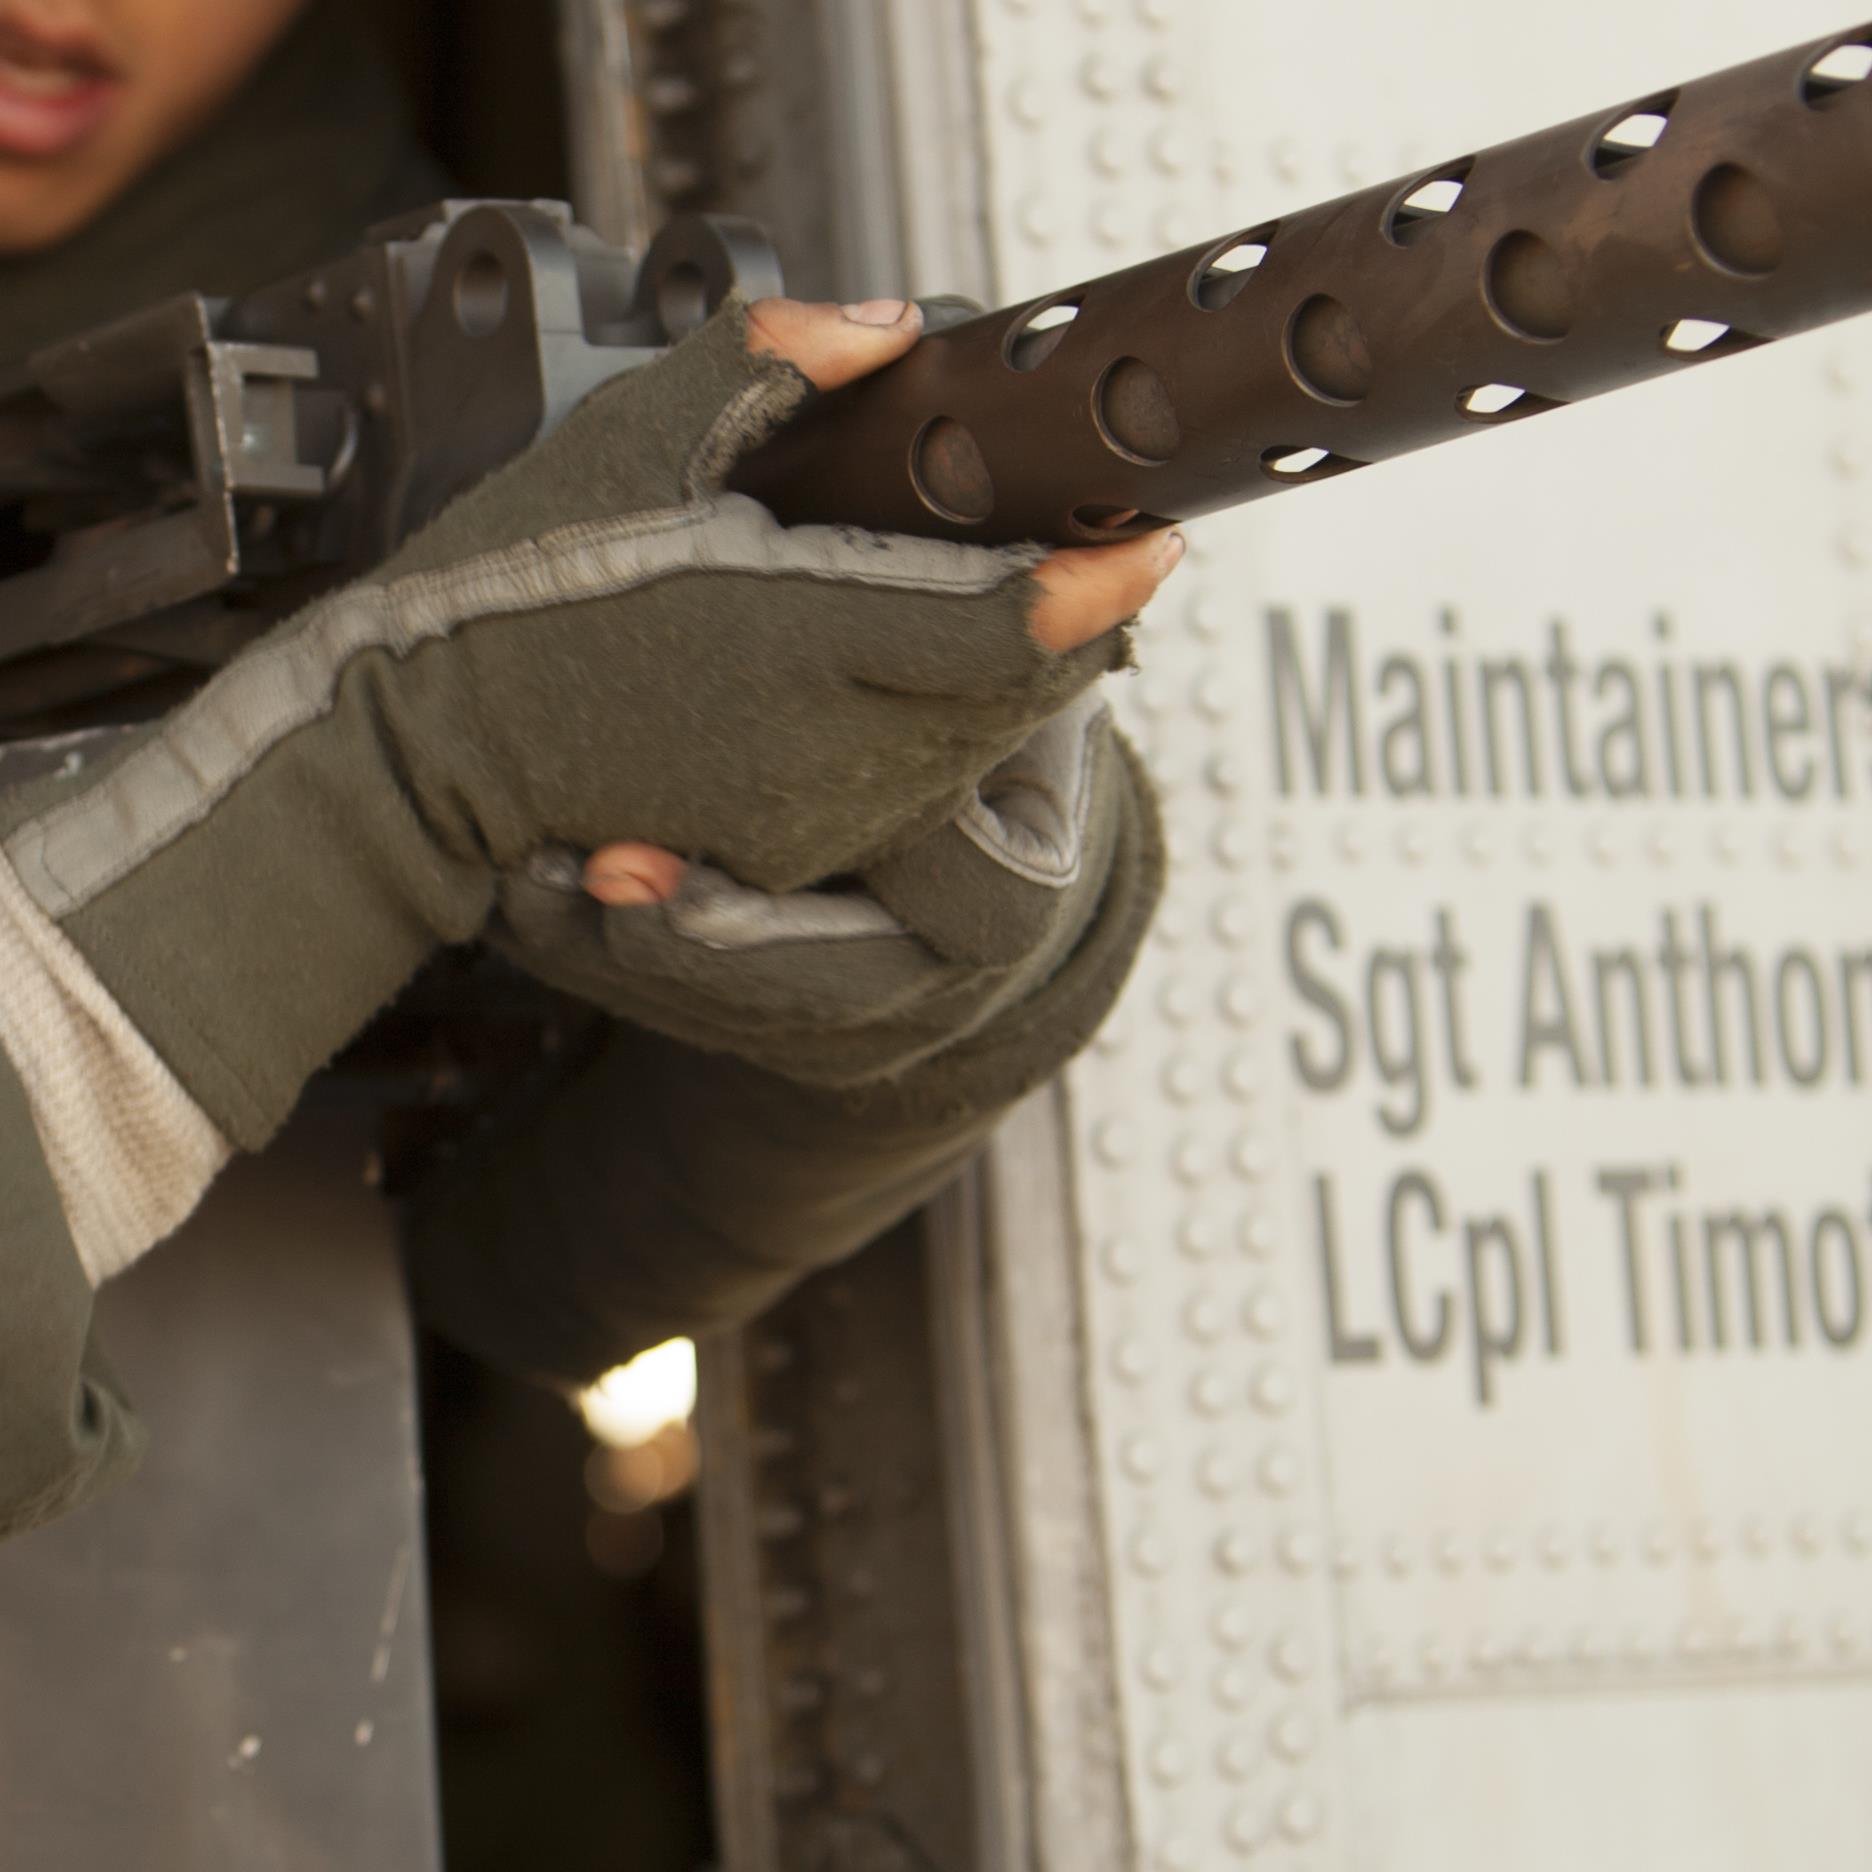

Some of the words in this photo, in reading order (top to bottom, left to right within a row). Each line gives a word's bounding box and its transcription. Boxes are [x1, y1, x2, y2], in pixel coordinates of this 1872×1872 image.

[1281, 894, 1477, 1140] Sgt
[1311, 1164, 1564, 1409] LCpl
[1595, 1158, 1872, 1358] Timo
